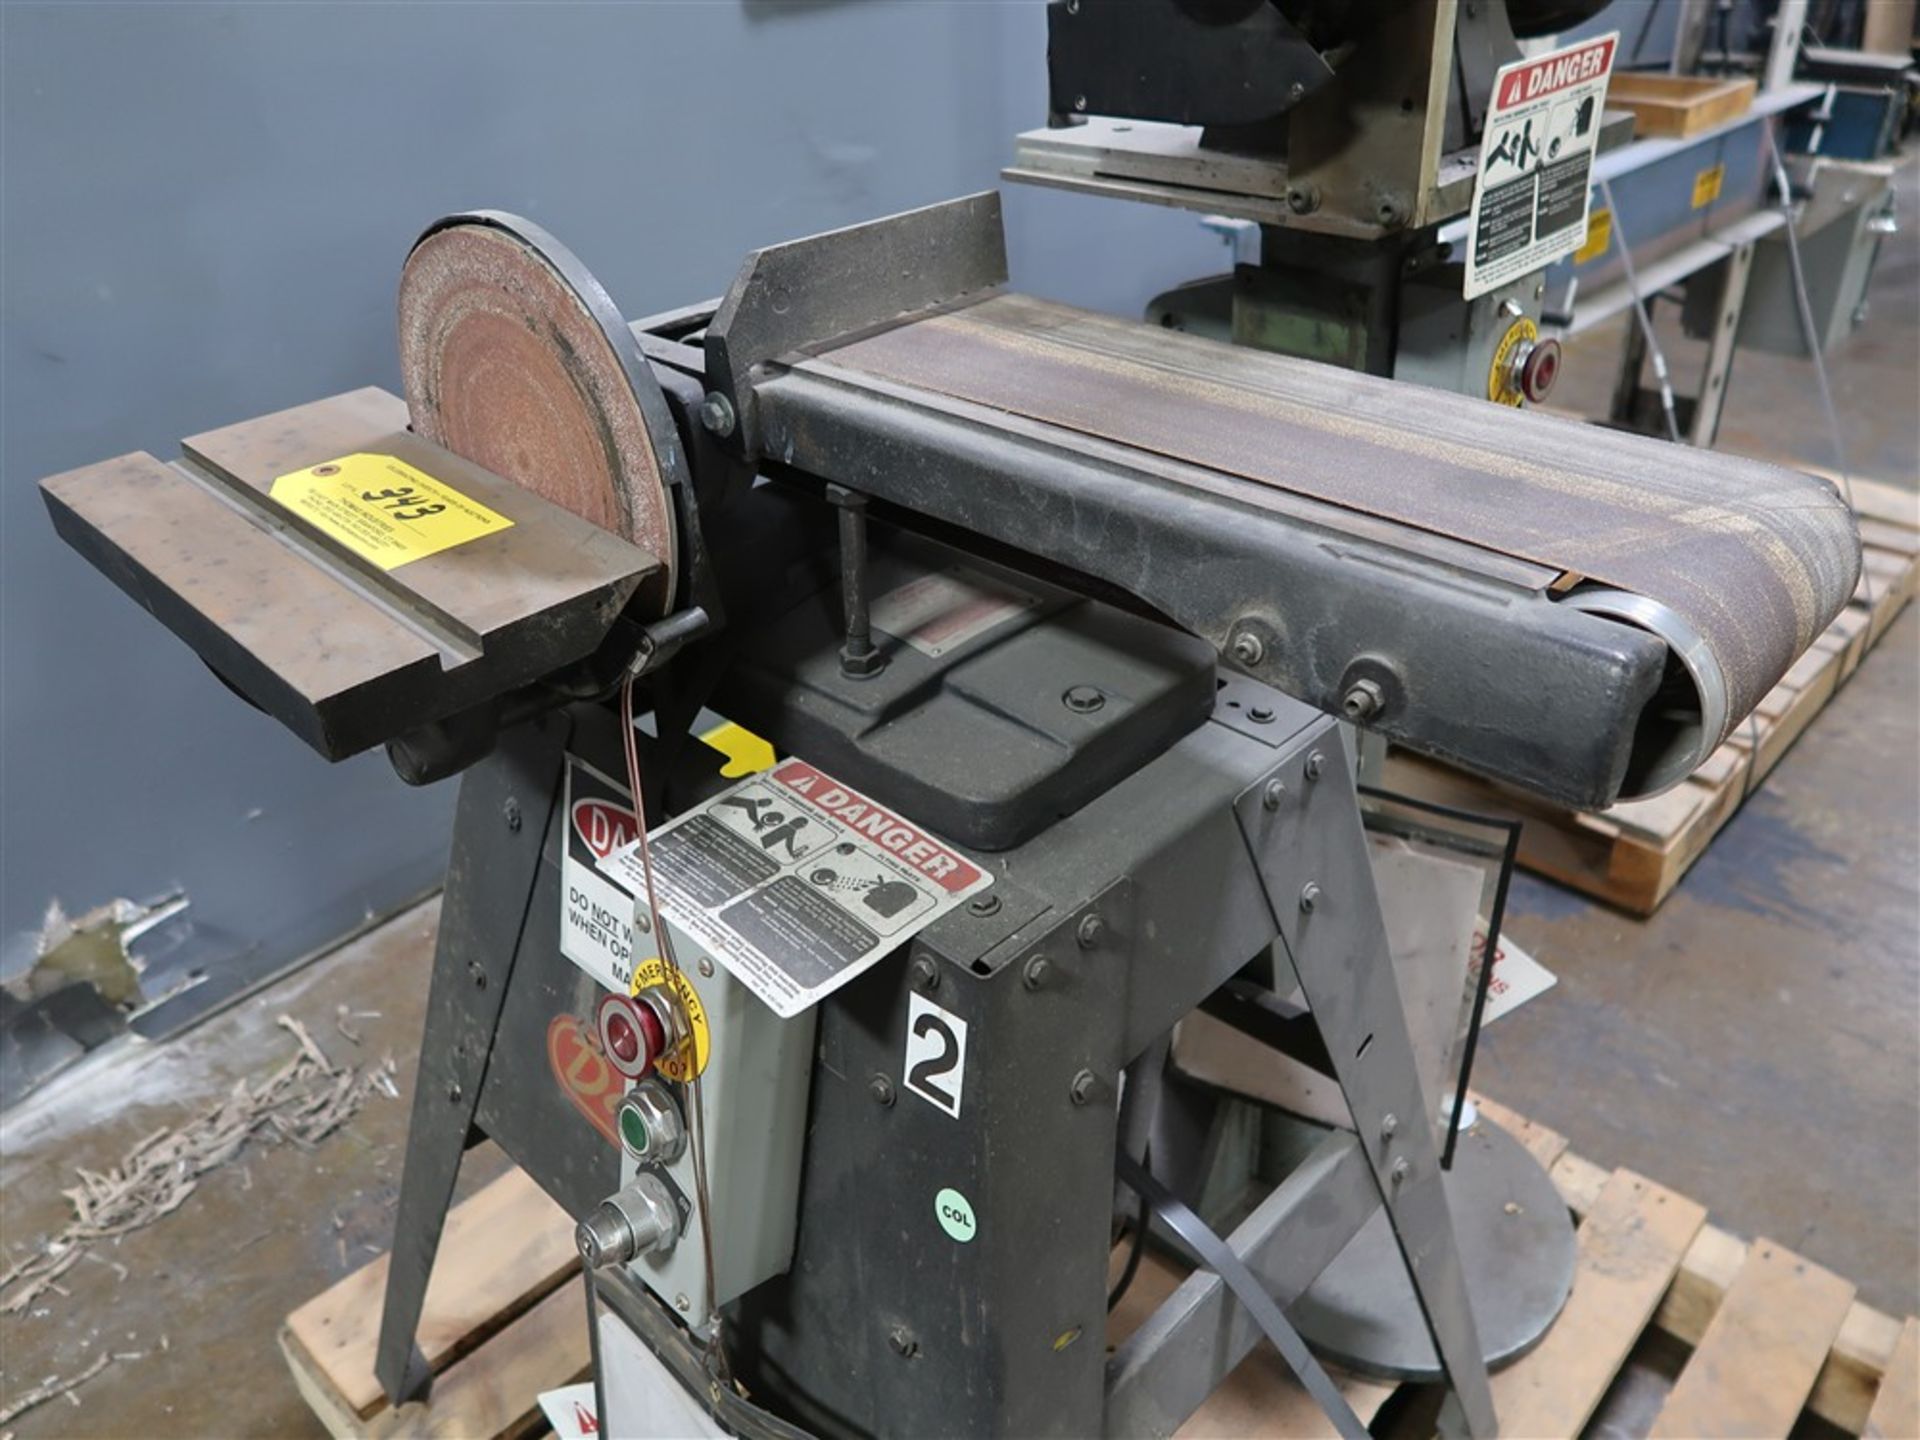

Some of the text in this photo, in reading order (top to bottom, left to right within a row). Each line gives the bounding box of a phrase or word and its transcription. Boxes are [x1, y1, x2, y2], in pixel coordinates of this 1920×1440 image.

[1526, 46, 1606, 98] DANGER
[361, 486, 447, 521] 343
[592, 805, 636, 856] DA
[816, 788, 959, 879] DANGER
[568, 906, 630, 961] WHEN OP
[570, 886, 589, 911] DO
[591, 902, 619, 932] NOT
[908, 1012, 960, 1111] 2
[942, 1204, 972, 1229] COL
